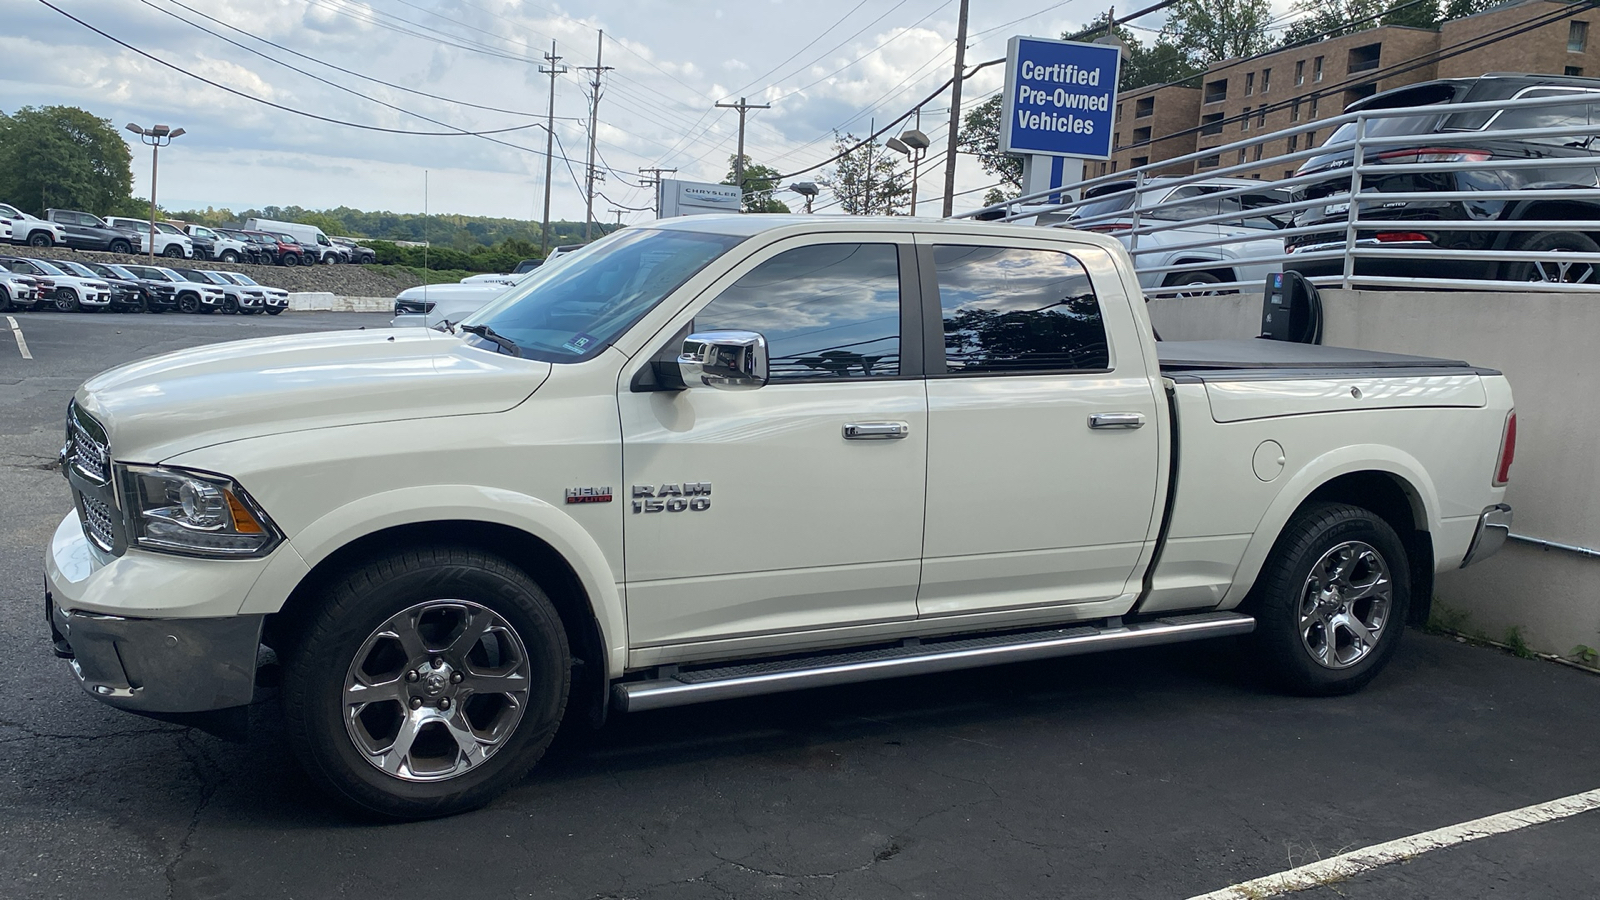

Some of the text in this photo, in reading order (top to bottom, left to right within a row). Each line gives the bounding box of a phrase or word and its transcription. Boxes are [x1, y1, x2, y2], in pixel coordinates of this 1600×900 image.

[1021, 60, 1100, 86] Certified
[1019, 85, 1109, 112] Pre-Owned
[1018, 110, 1094, 134] Vehicles
[685, 187, 737, 197] CHRYSLER
[565, 487, 613, 497] HEMI
[632, 482, 712, 498] RAM
[632, 497, 712, 514] 1500
